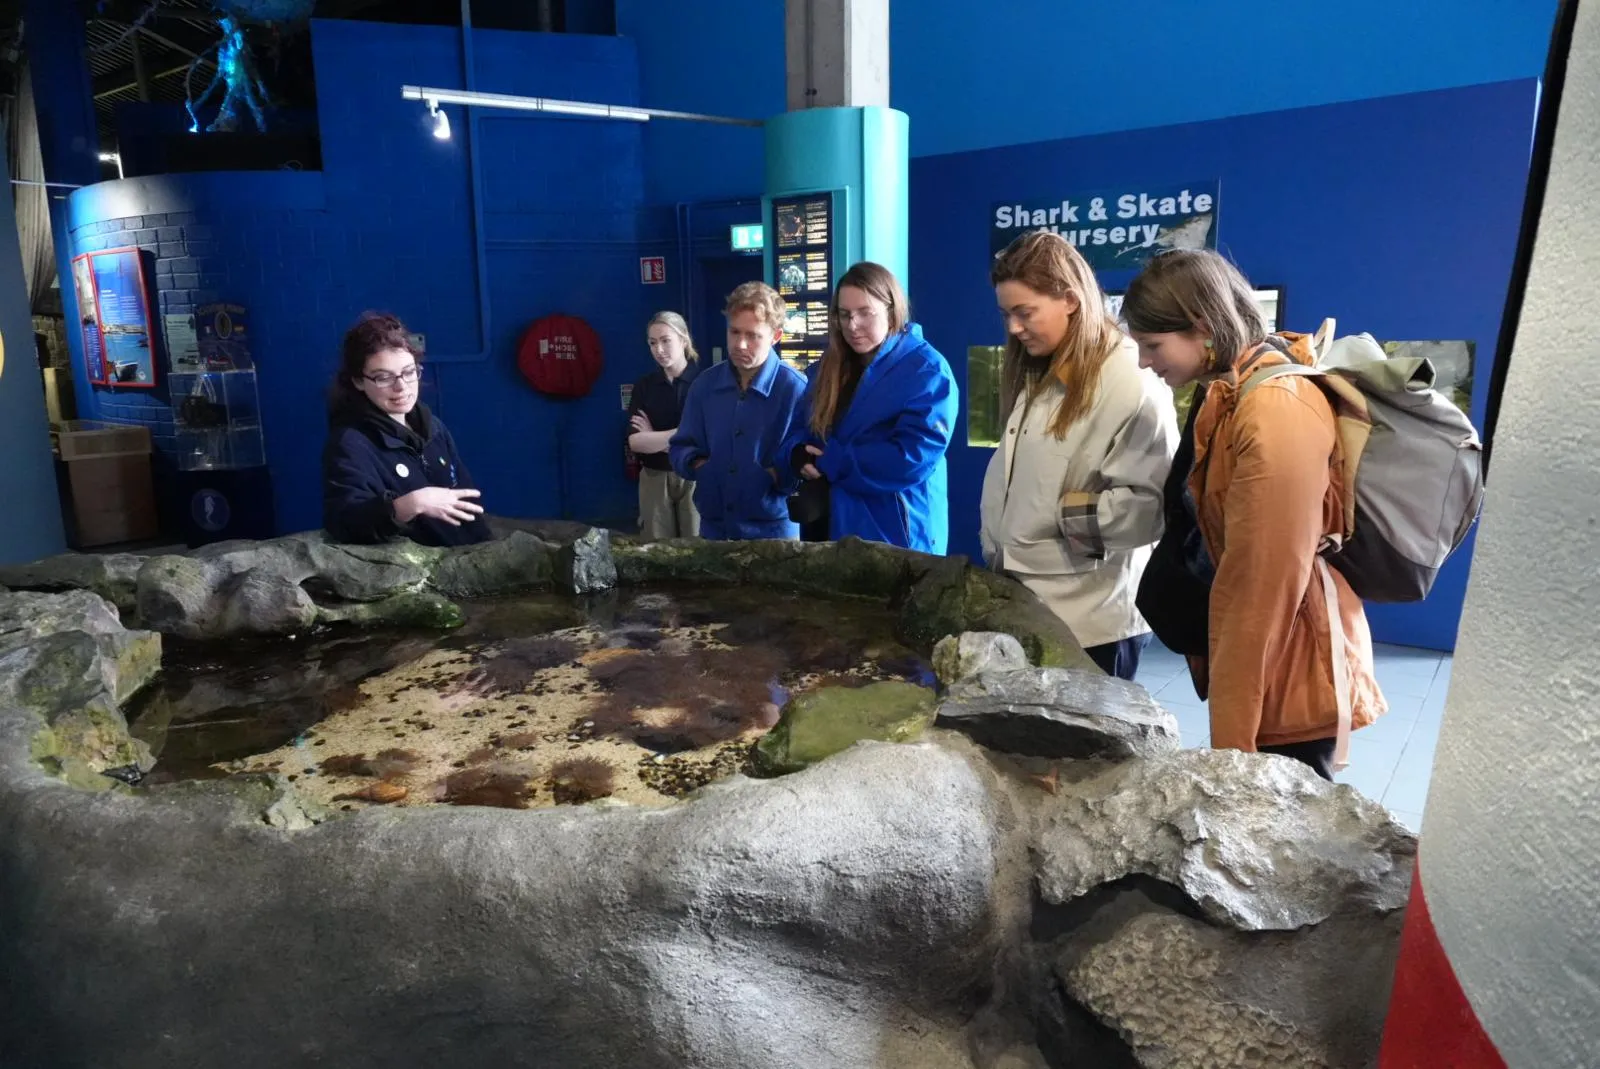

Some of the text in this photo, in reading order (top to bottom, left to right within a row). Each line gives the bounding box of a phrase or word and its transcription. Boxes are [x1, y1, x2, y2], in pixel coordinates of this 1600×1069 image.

[995, 189, 1213, 229] Shark & Skate
[554, 335, 573, 343] FIRE
